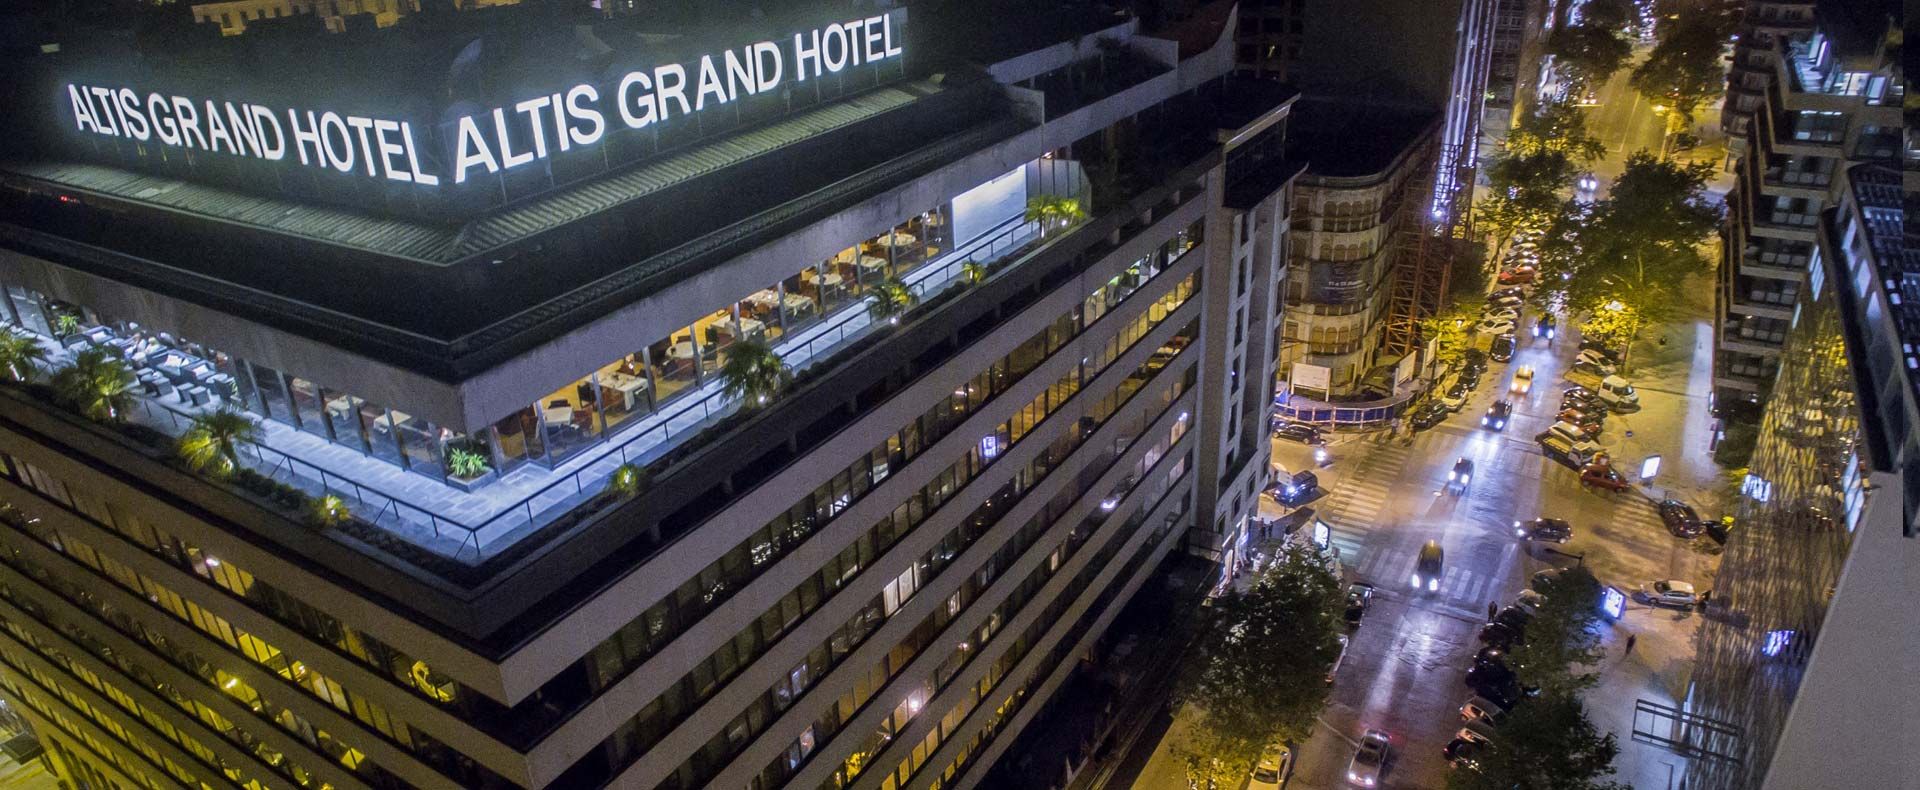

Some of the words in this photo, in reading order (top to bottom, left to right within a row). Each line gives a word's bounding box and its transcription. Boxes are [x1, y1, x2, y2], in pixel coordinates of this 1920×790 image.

[68, 83, 150, 141] ALTIS
[147, 93, 285, 160] GRAND
[288, 108, 439, 186] HOTEL
[455, 84, 605, 184] ALTIS
[617, 41, 783, 129] GRAND
[794, 13, 902, 82] HOTEL
